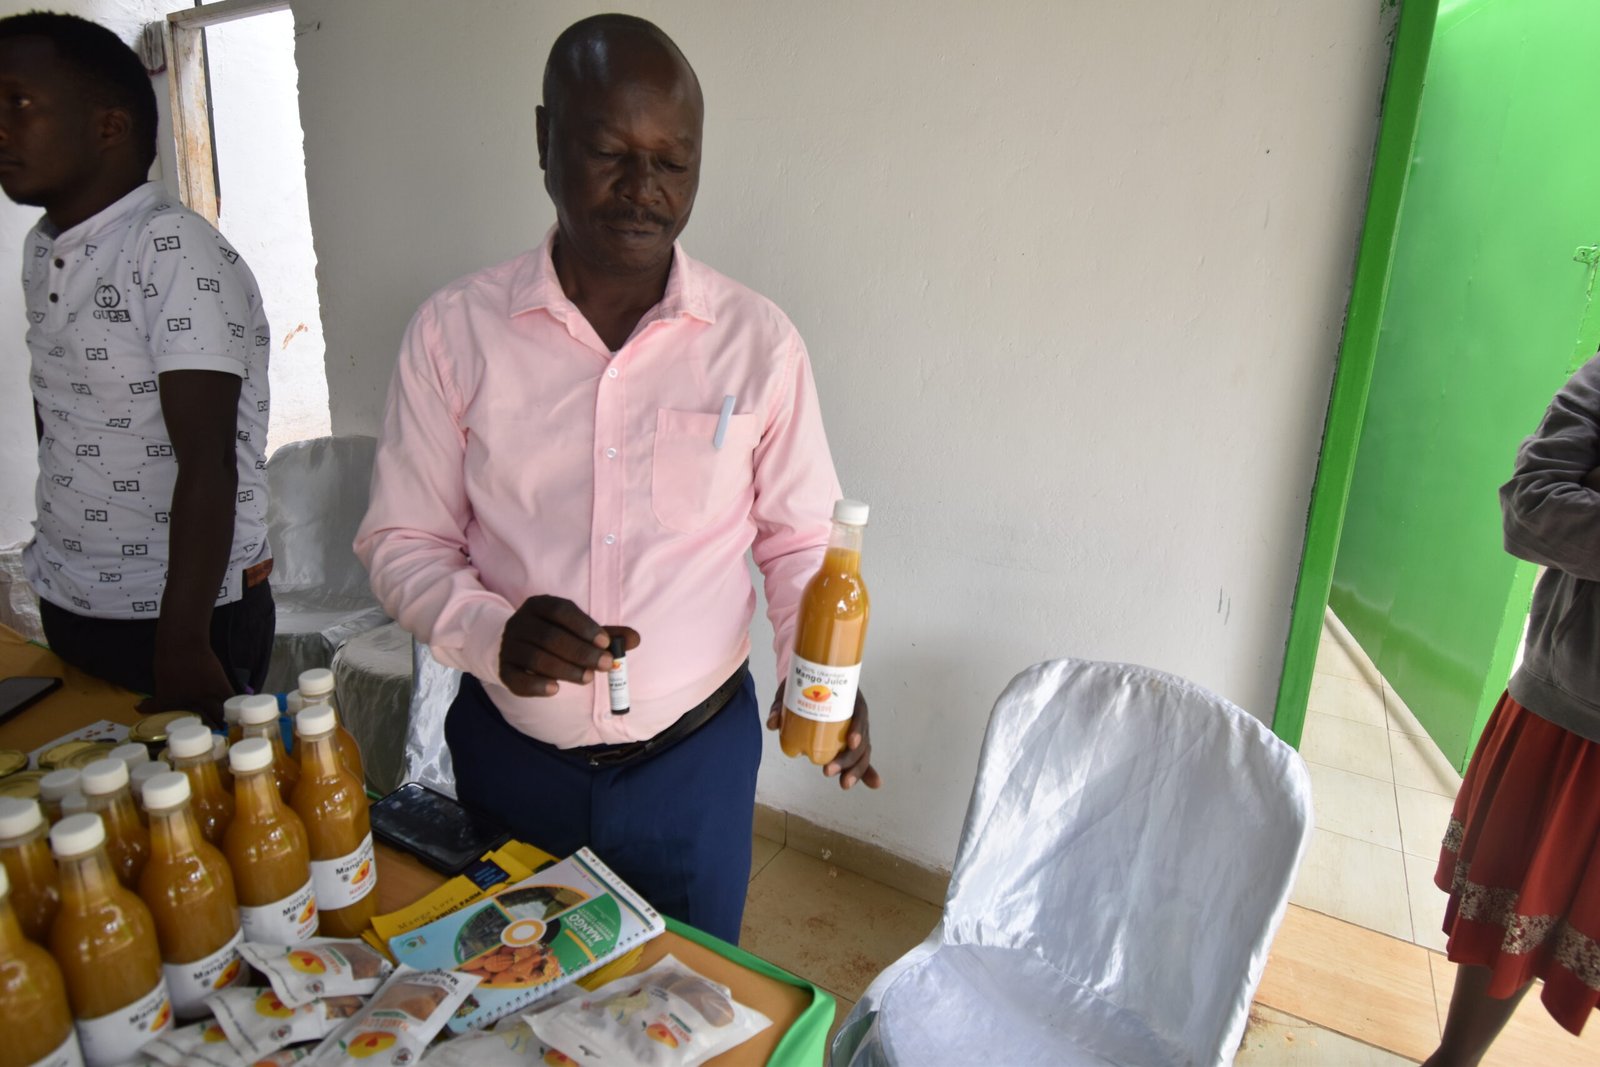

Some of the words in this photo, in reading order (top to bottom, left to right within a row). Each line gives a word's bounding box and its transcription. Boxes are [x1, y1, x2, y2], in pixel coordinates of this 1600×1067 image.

[796, 667, 822, 684] Mango
[824, 676, 848, 686] Juice
[568, 912, 602, 942] MANGO
